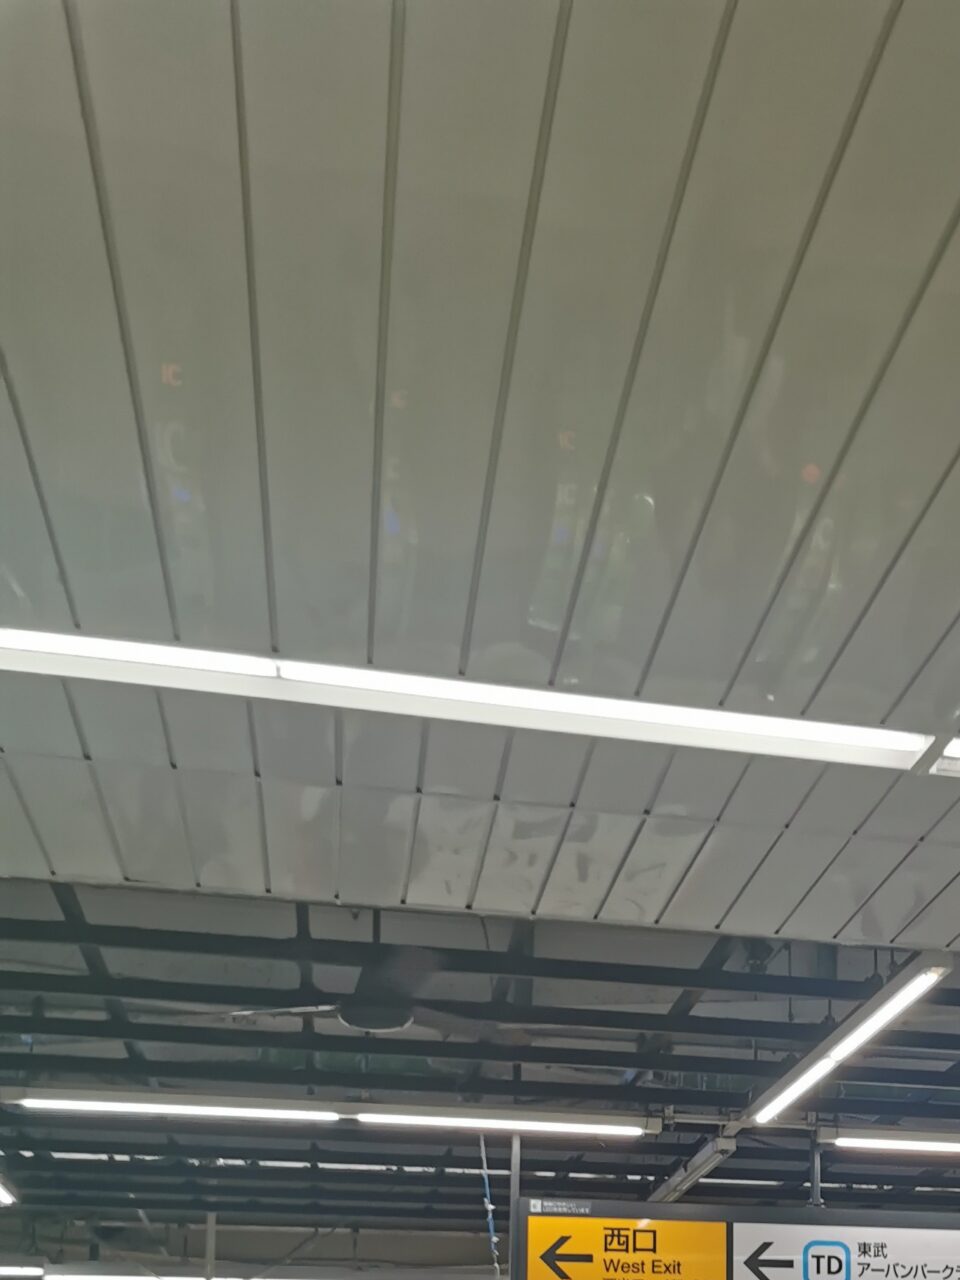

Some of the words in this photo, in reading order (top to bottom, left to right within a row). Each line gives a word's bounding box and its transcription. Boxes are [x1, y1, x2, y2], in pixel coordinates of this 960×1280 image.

[603, 1227, 657, 1253] 西口
[857, 1241, 888, 1259] 東武
[603, 1259, 645, 1274] West
[651, 1260, 681, 1275] Exit
[811, 1254, 843, 1275] TD
